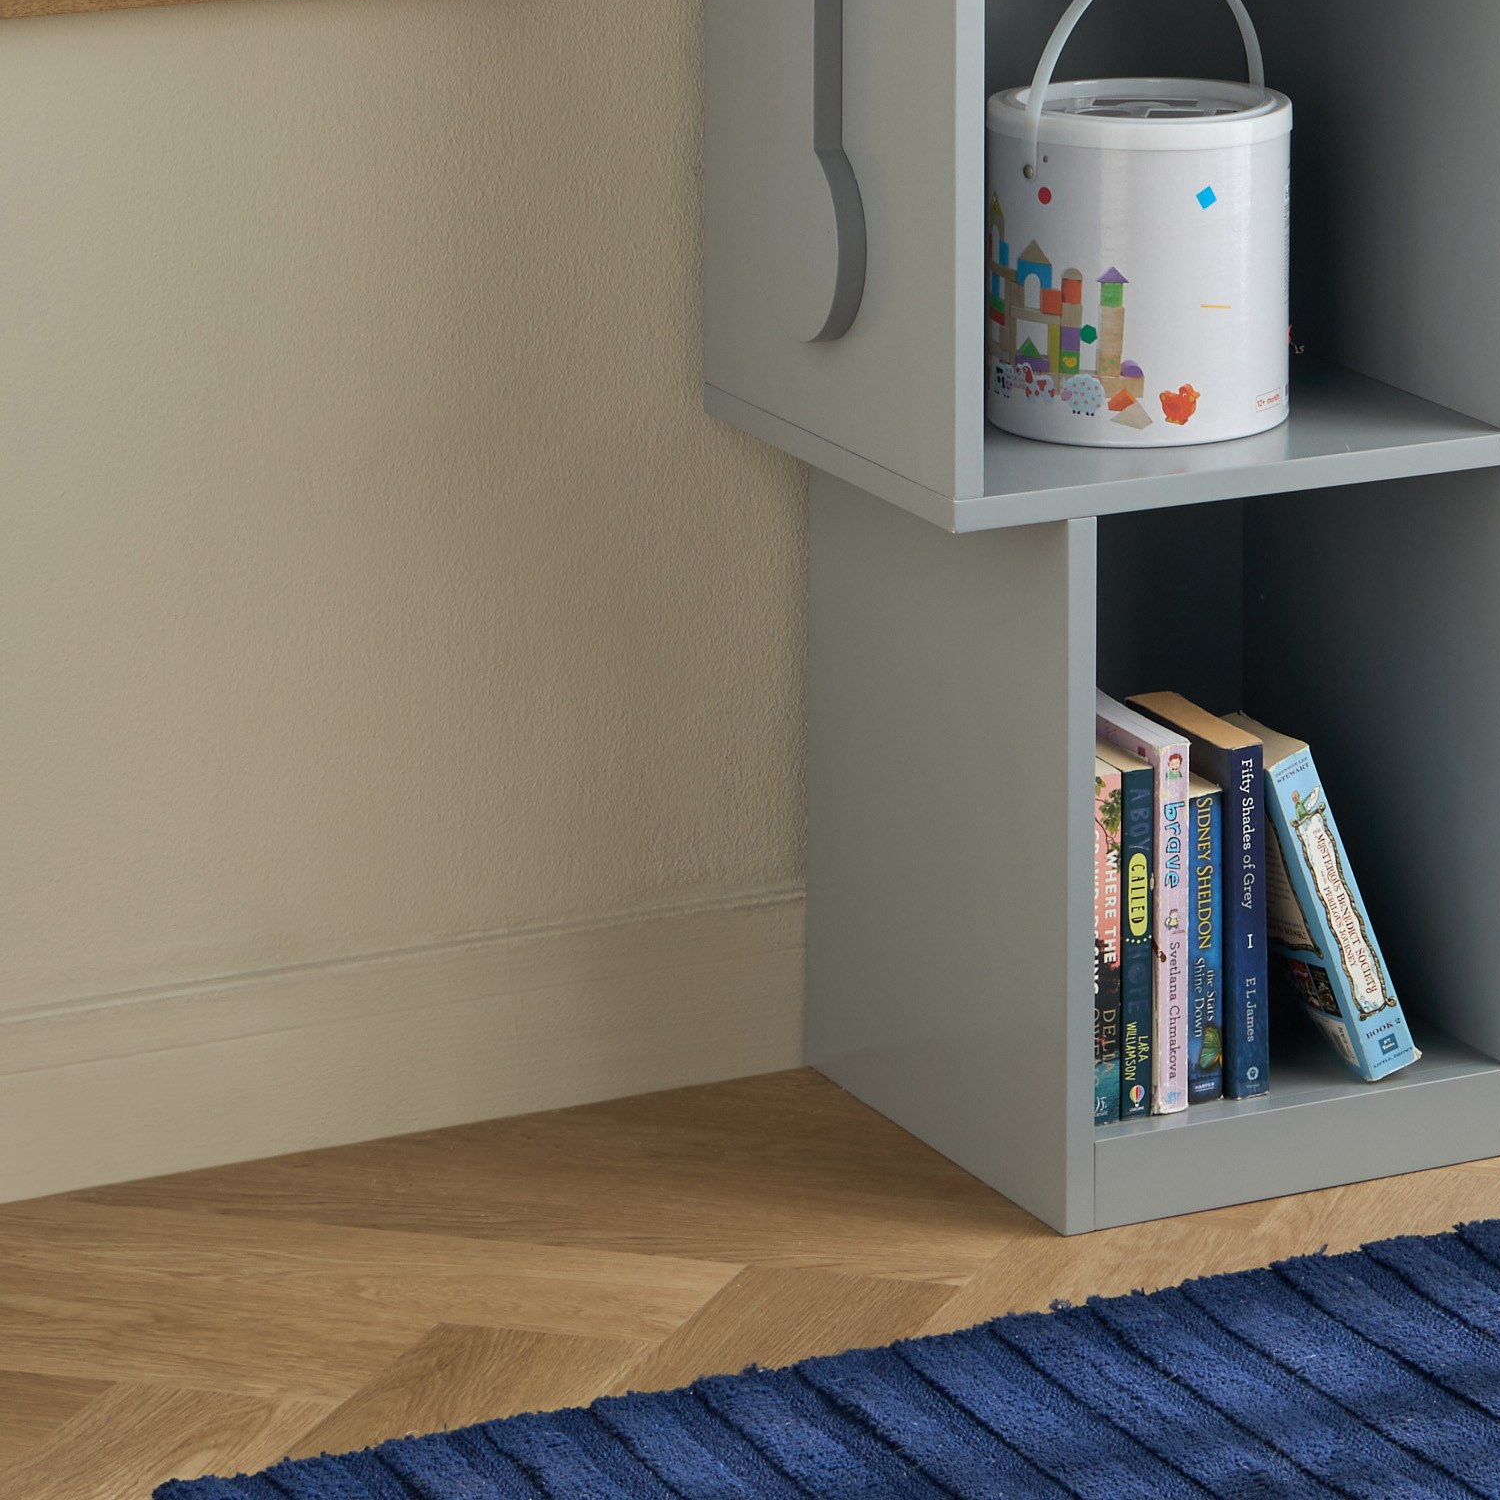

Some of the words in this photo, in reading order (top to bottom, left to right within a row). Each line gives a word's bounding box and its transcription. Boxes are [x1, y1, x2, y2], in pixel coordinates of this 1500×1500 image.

[1257, 399, 1265, 408] 12+
[1240, 758, 1253, 793] Fifty
[1277, 762, 1310, 784] STEWART
[1129, 788, 1150, 801] A
[1128, 810, 1150, 851] BOY
[1196, 797, 1213, 861] SIDNEY
[1242, 797, 1255, 850] Shades
[1163, 801, 1185, 889] brave
[1243, 855, 1256, 871] of
[1105, 849, 1119, 920] WHERE
[1130, 863, 1146, 925] CALLED
[1242, 873, 1255, 909] Grey
[1196, 865, 1214, 949] SHELDON
[1315, 830, 1342, 892] MYSTERIOUS
[1336, 892, 1361, 945] BENEDICT
[1356, 948, 1378, 994] SOCIETY
[1323, 887, 1343, 929] PERILOUS
[1339, 929, 1358, 967] JOURNEY
[1103, 926, 1117, 964] THE
[1127, 947, 1149, 1015] HOPE
[1169, 941, 1180, 1000] Svetlana
[1194, 957, 1205, 994] Shine
[1206, 969, 1216, 986] the
[1246, 977, 1256, 987] E
[1207, 990, 1217, 1022] Stars
[1246, 989, 1256, 999] L
[1194, 998, 1205, 1038] Down
[1247, 1002, 1257, 1042] James
[1366, 1022, 1393, 1039] BOOK
[1102, 1008, 1117, 1074] DELIA
[1125, 1021, 1137, 1081] WILLIAMSON
[1138, 1035, 1149, 1063] LARA
[1169, 1005, 1181, 1079] Chmakova
[1195, 1082, 1215, 1090] HARPER
